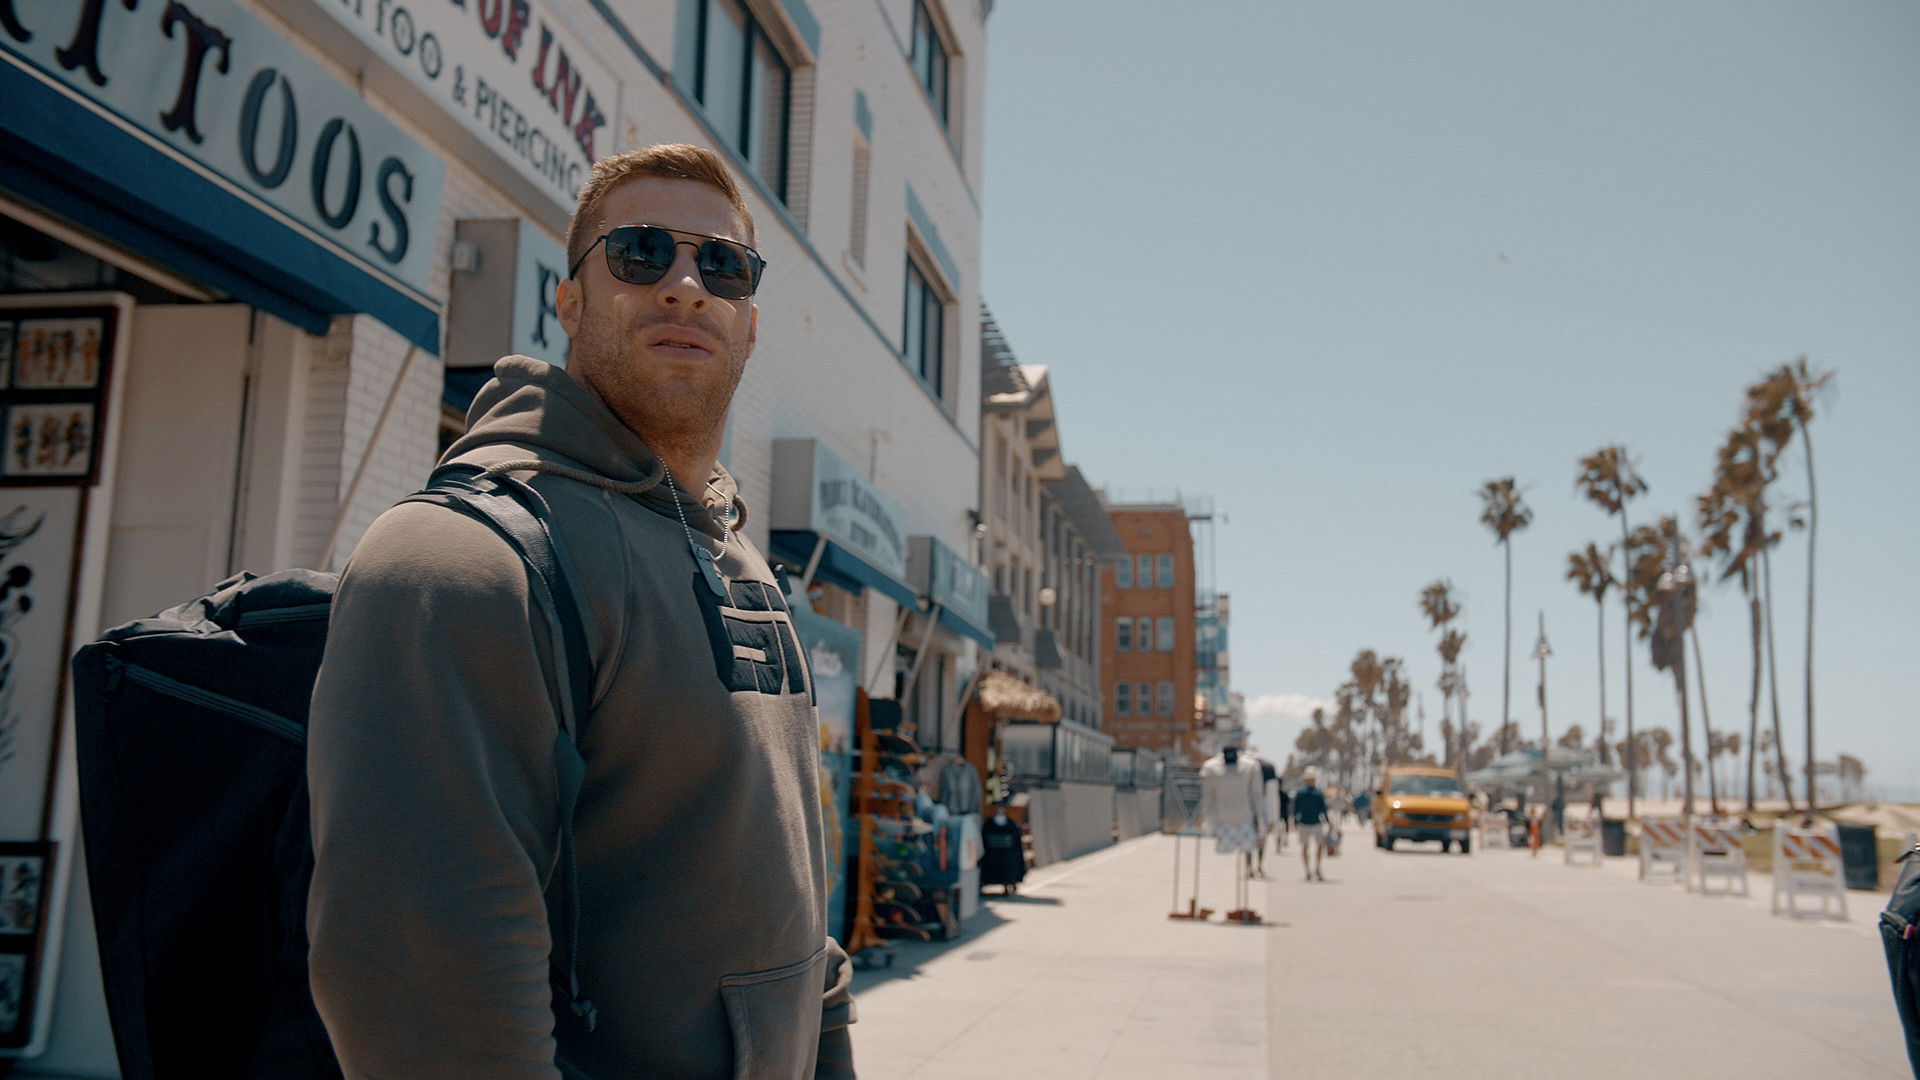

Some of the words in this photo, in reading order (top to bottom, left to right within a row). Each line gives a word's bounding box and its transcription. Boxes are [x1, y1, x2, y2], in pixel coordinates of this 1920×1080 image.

[0, 0, 415, 264] TTOOS
[453, 65, 466, 107] &
[475, 76, 582, 200] PIERCING
[531, 19, 605, 165] INK
